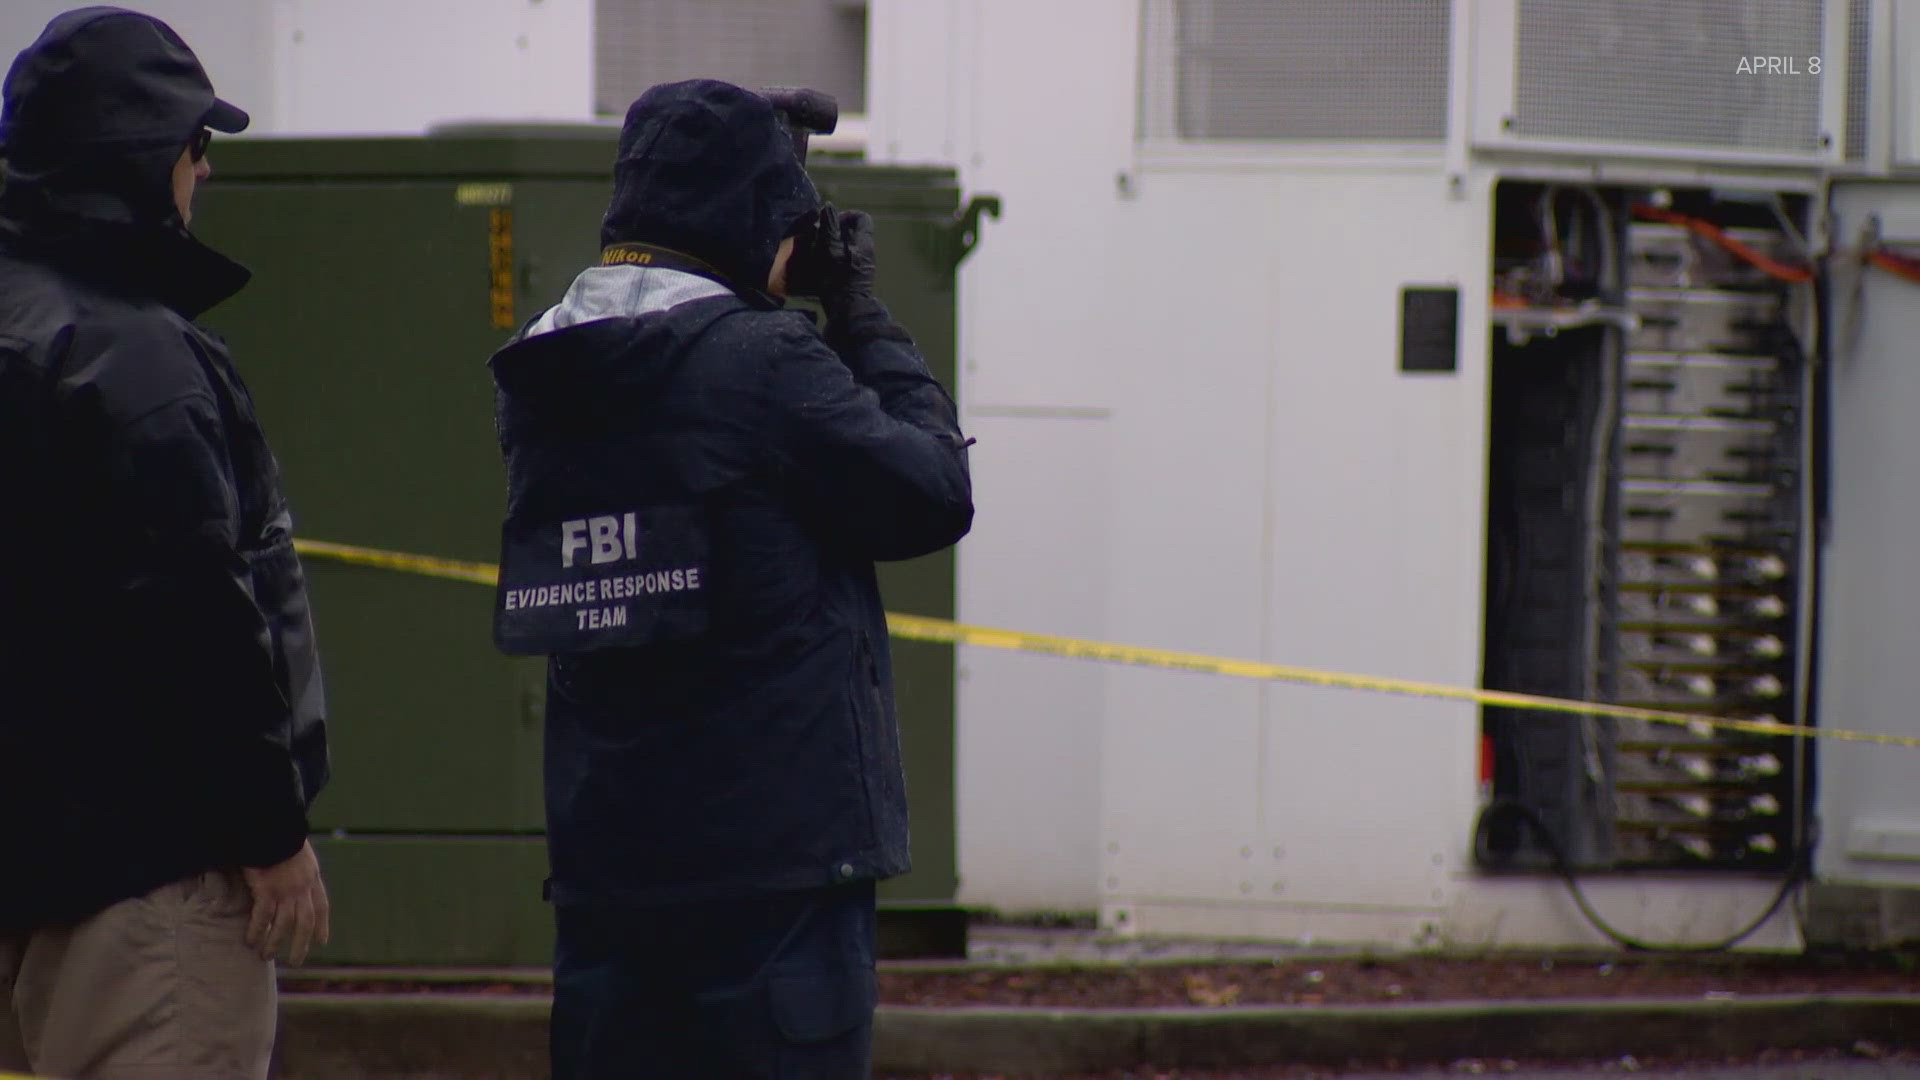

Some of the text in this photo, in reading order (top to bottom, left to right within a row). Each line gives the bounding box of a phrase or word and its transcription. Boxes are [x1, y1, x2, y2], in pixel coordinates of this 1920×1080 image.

[601, 248, 652, 266] Nikon
[561, 512, 637, 568] FBI
[505, 568, 700, 610] EVIDENCE RESPONSE
[576, 605, 627, 630] TEAM
